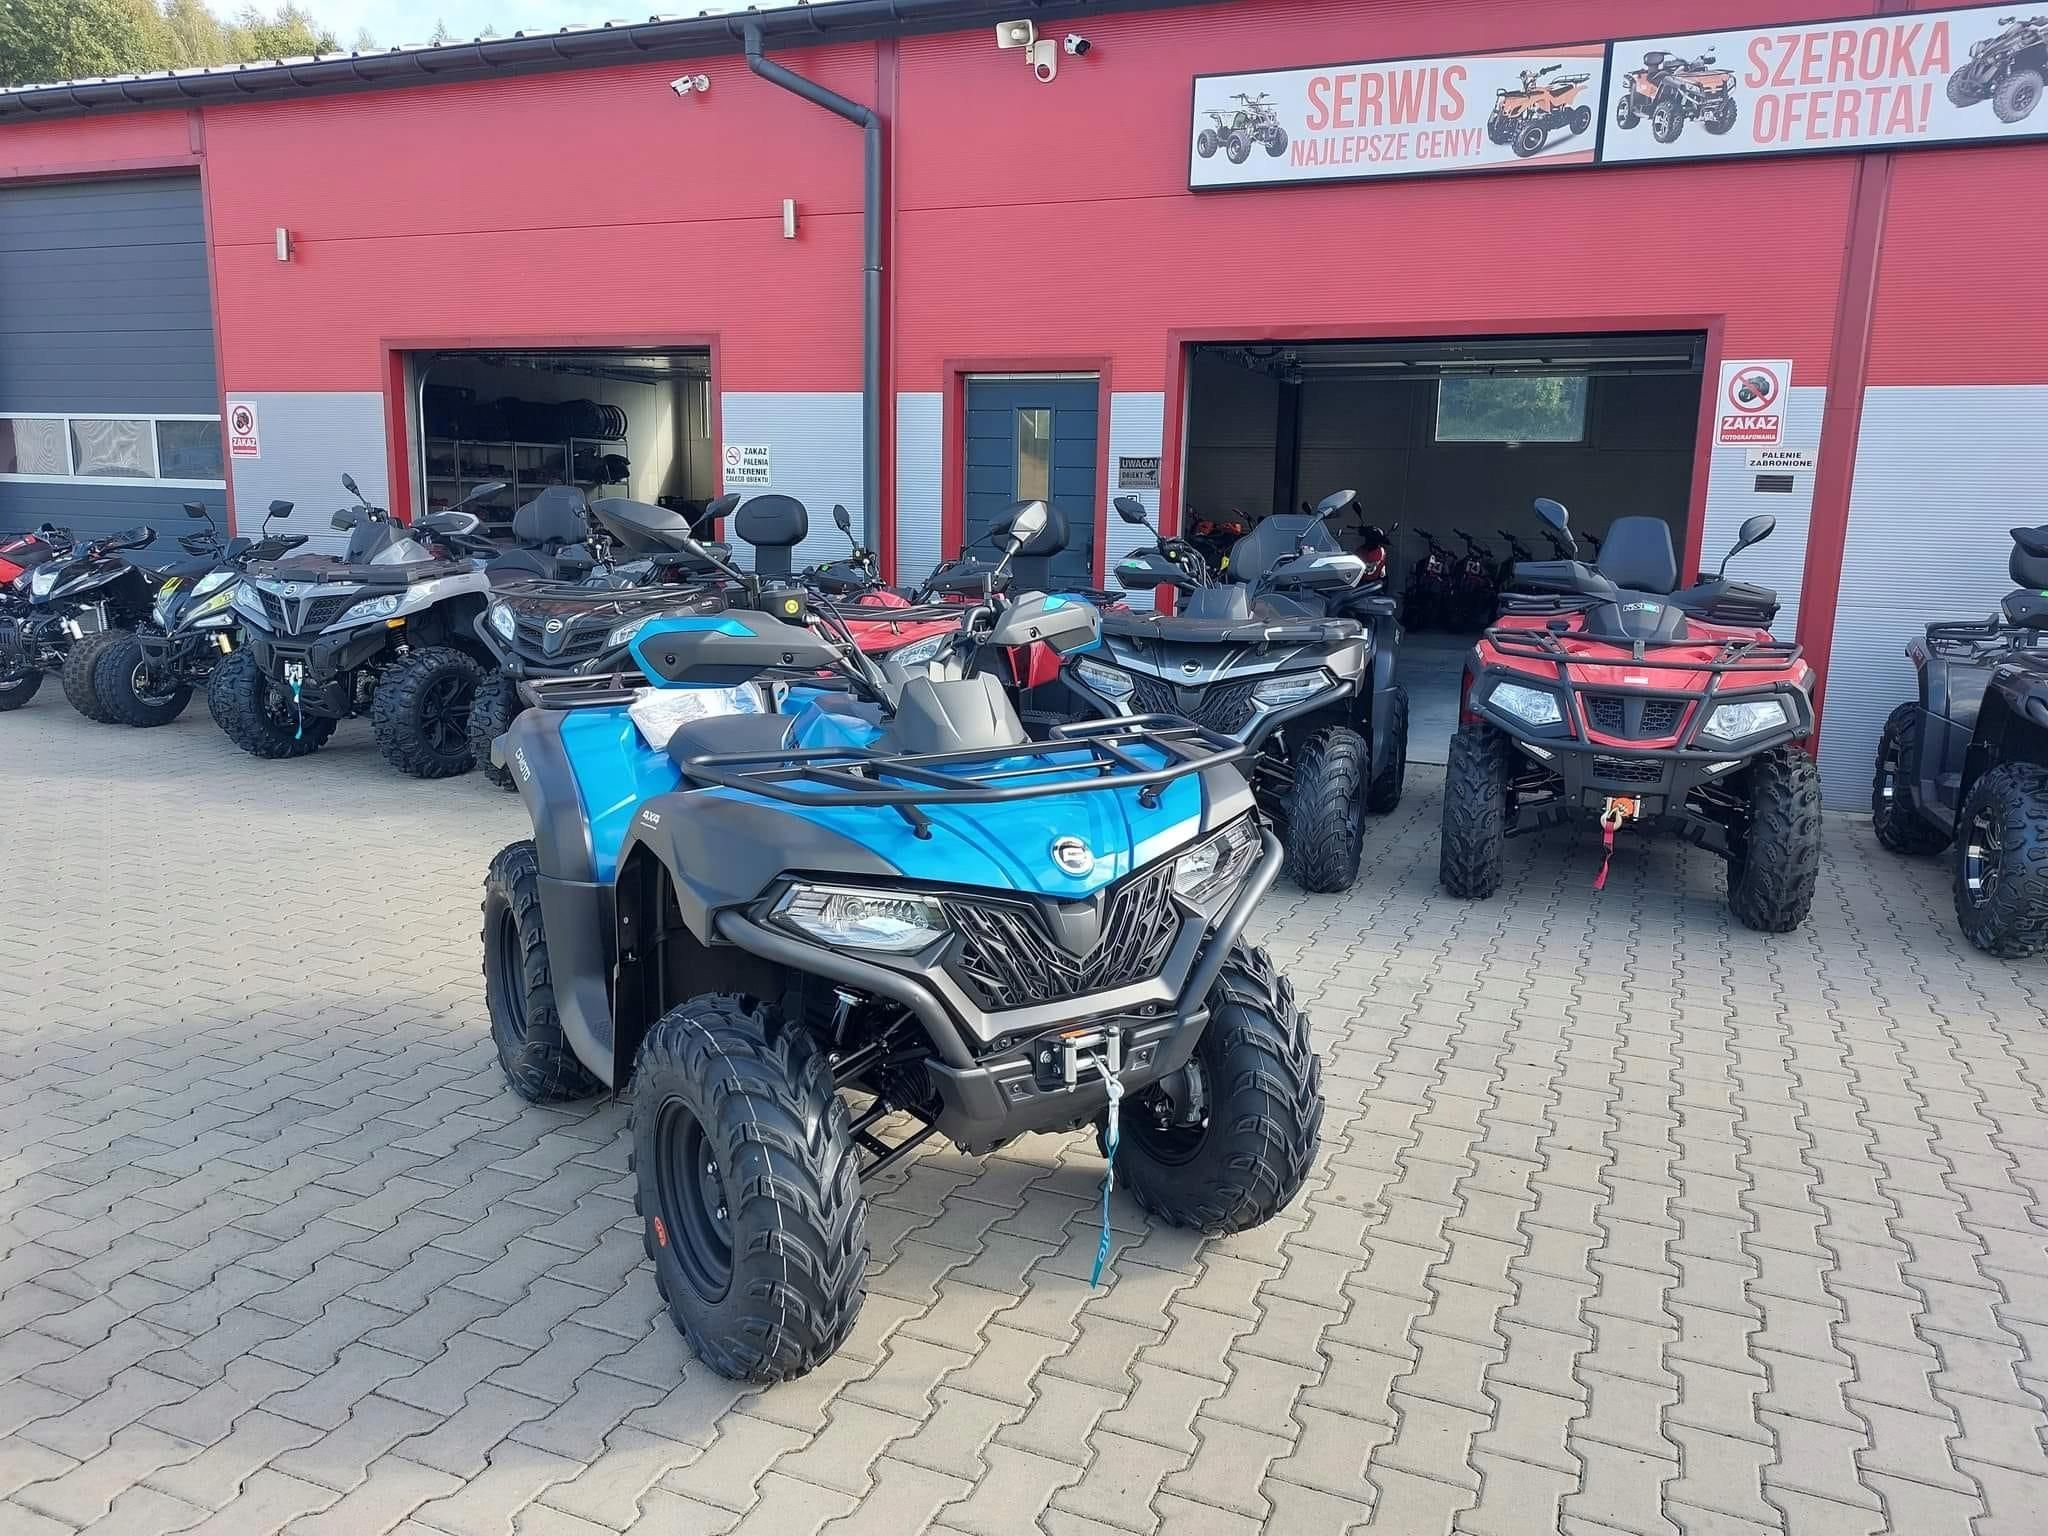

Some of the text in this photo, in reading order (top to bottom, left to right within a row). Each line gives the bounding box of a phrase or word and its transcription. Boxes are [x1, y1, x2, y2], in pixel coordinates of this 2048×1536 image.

[1744, 21, 1950, 88] SZEROKA
[1306, 65, 1467, 131] SERWIS
[1752, 83, 1932, 144] OFERTA!
[1290, 128, 1482, 167] NAJLEPSZE CENY!
[1722, 416, 1778, 430] ZAKAZ
[232, 439, 257, 447] ZAKAZ
[744, 447, 768, 456] ZAKAZ
[1122, 459, 1158, 468] UWAGA!
[726, 467, 768, 476] NA TERENIE
